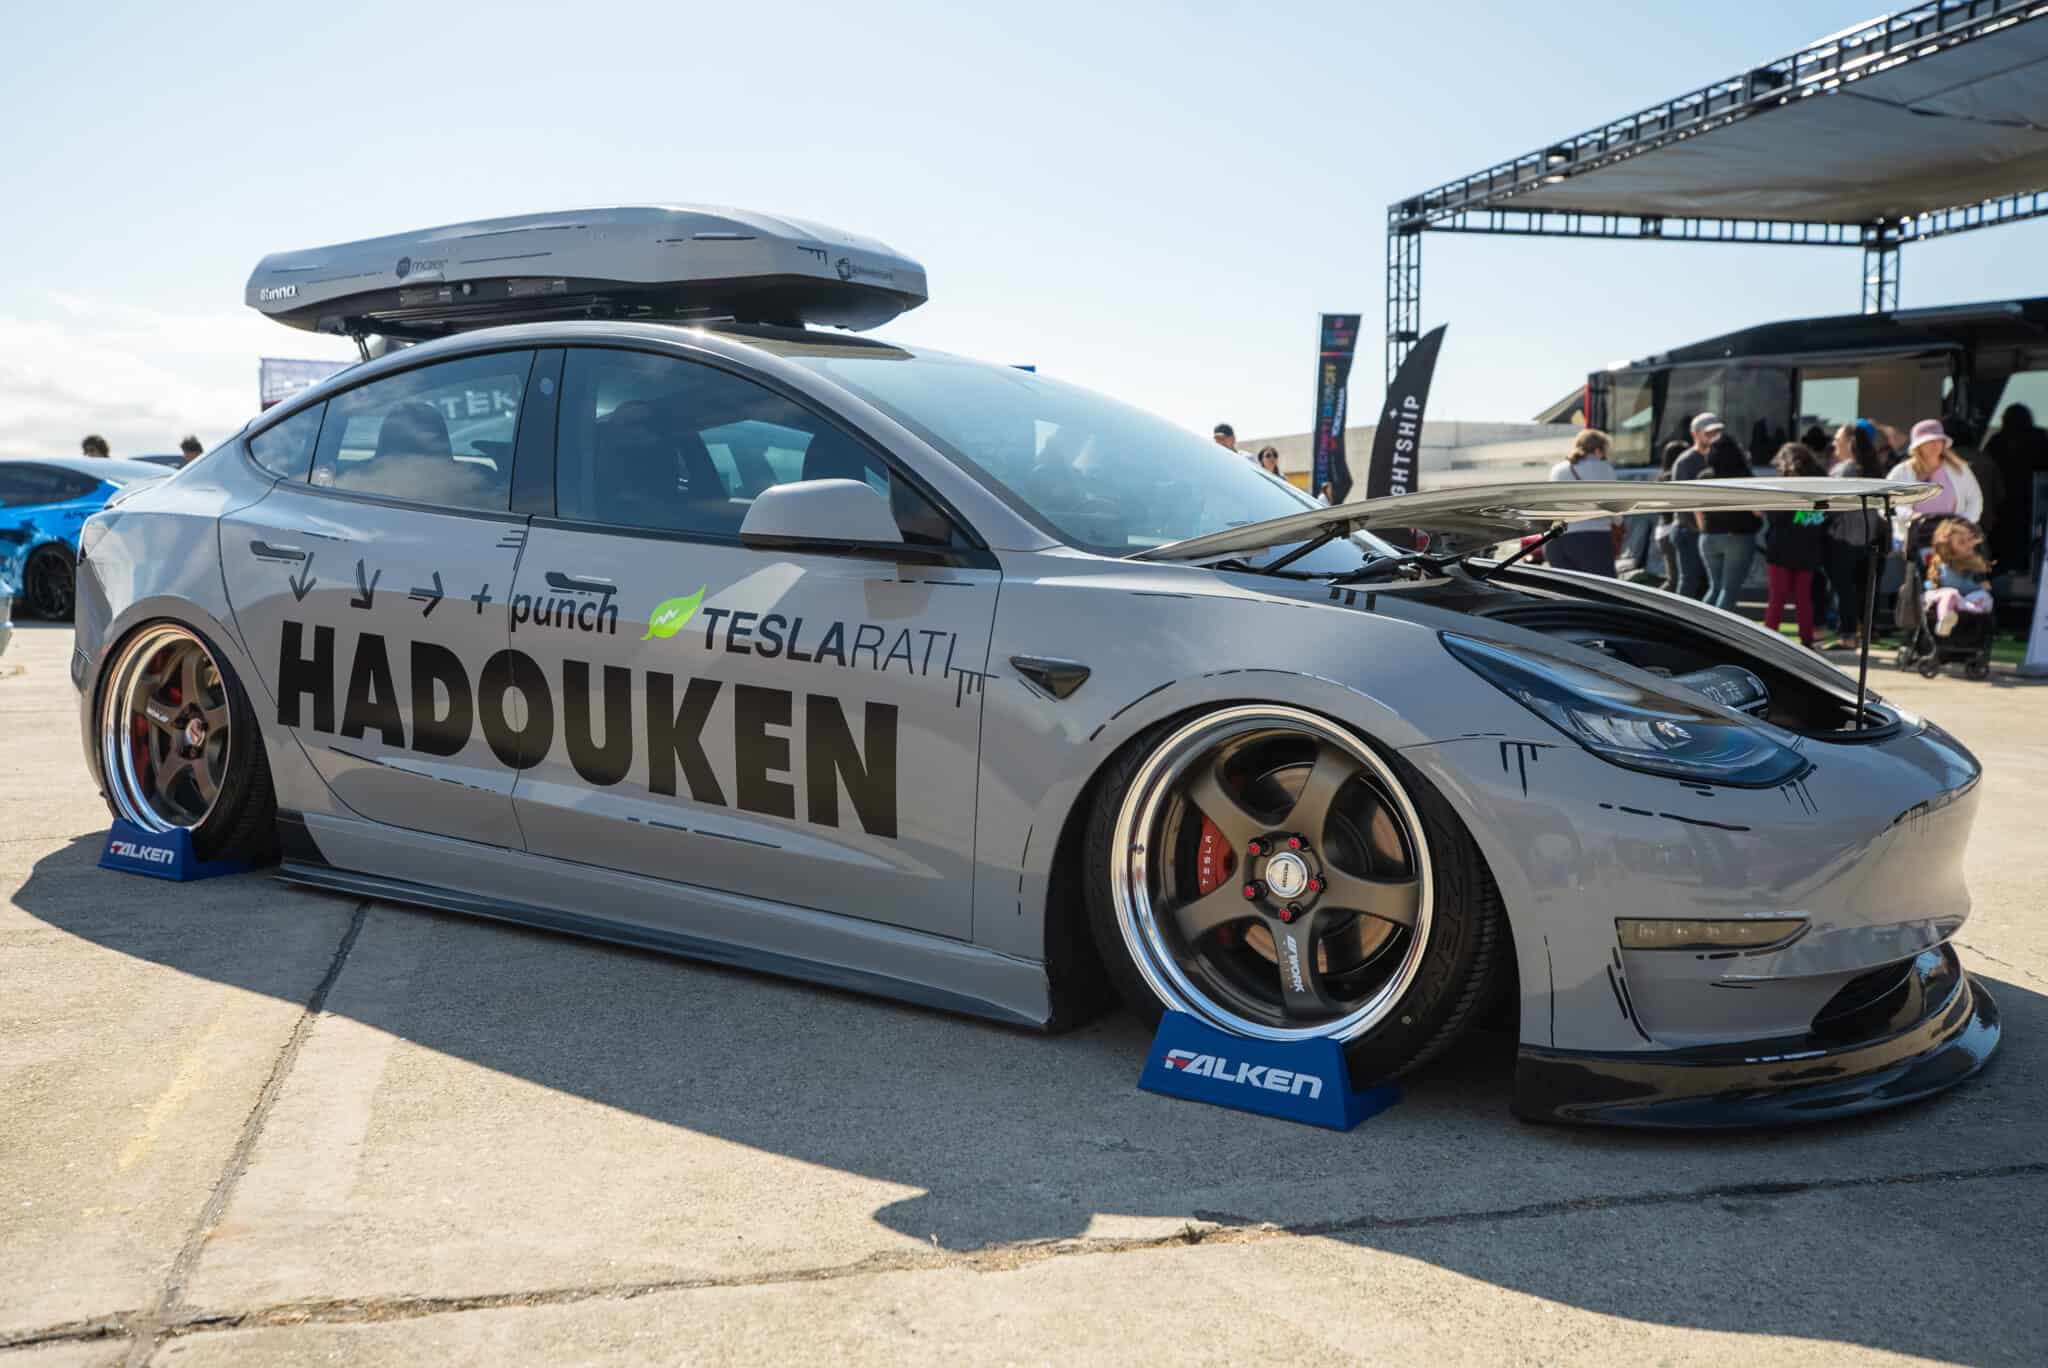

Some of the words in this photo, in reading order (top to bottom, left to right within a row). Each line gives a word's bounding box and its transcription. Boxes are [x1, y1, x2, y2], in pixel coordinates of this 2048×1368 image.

[510, 592, 618, 635] punch
[702, 607, 957, 679] TESLARATI
[277, 620, 898, 839] HADOUKEN
[110, 841, 175, 865] FALKEN
[1202, 835, 1212, 887] TESLA
[1162, 1049, 1323, 1100] FALKEN
